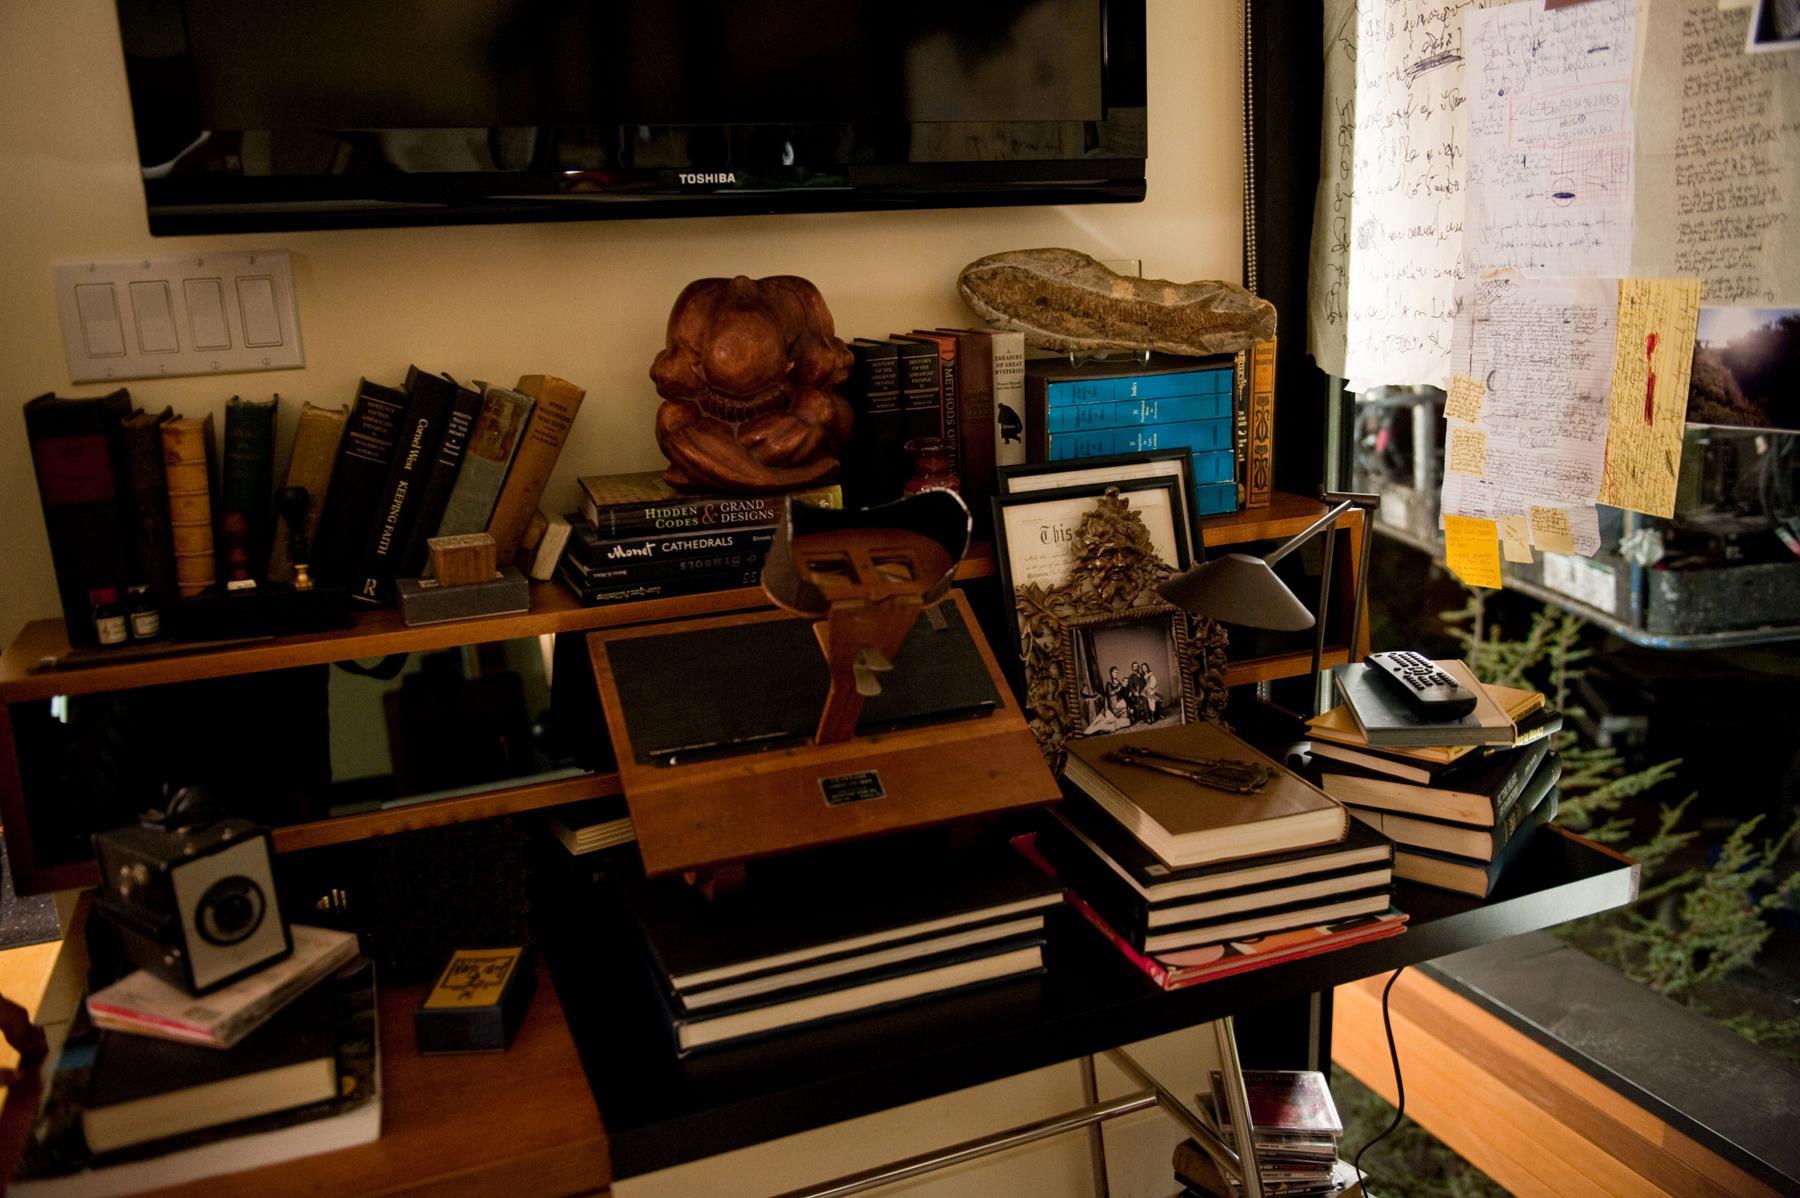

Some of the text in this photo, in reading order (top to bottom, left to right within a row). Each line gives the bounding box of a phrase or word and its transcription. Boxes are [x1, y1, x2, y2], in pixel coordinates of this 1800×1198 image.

[678, 172, 736, 185] TOSHIBA
[944, 368, 956, 425] METHODS
[377, 418, 429, 556] Cornel West KEEPING FAITH
[645, 506, 698, 520] HIDDEN
[701, 503, 719, 525] &
[719, 499, 765, 513] GRAND
[655, 517, 699, 530] CODES
[720, 509, 775, 524] DESIGNS
[1039, 523, 1073, 545] This
[607, 542, 657, 560] Monet
[661, 536, 734, 552] CATHEDRALS
[362, 577, 378, 596] R
